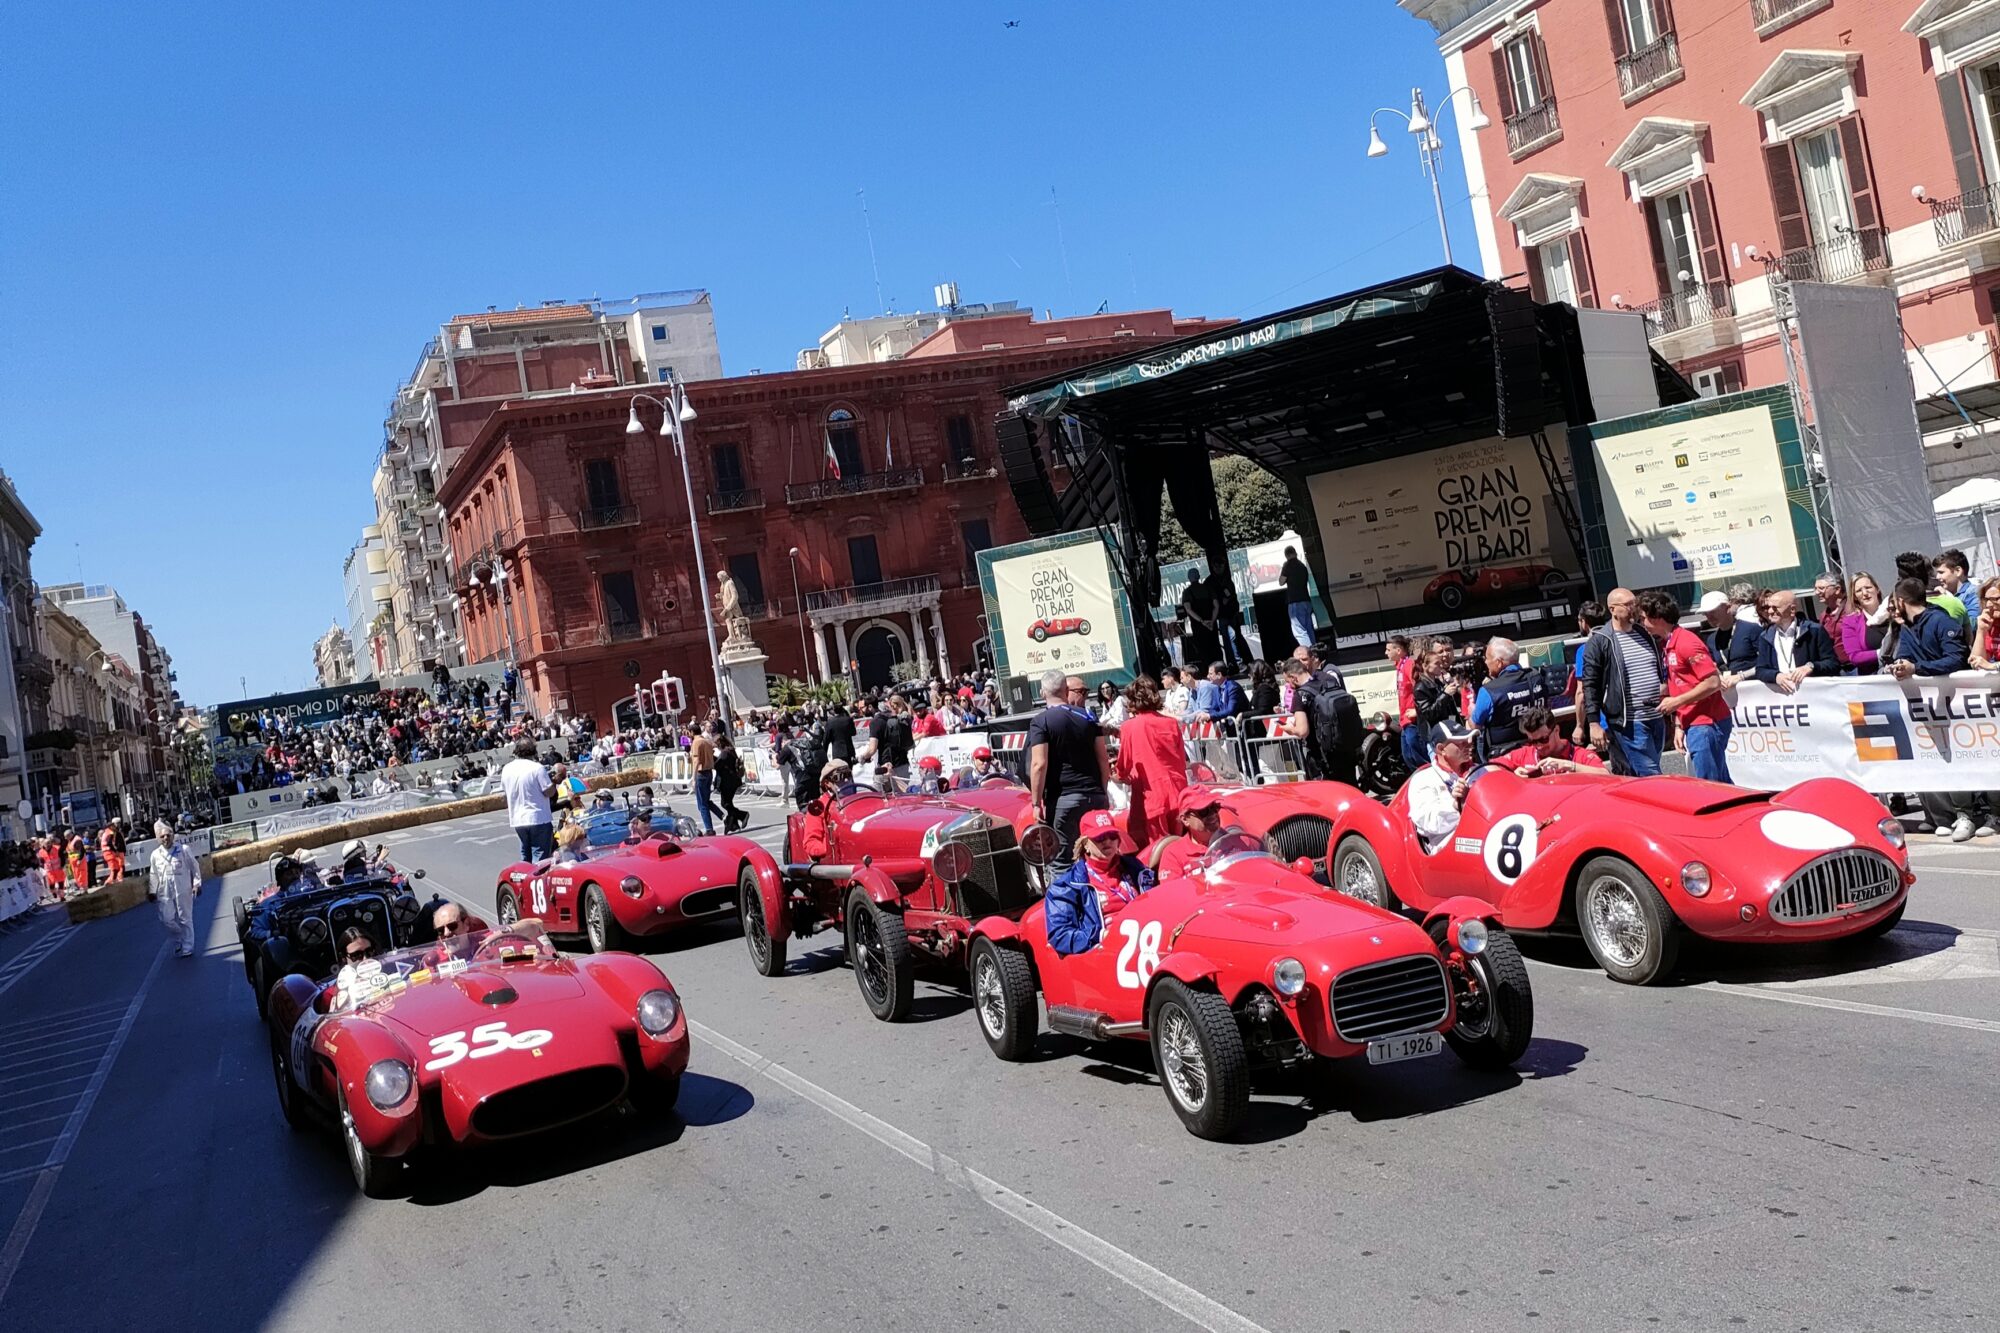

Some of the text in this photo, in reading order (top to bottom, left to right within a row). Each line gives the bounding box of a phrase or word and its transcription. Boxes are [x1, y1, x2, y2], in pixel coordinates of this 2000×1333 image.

[1181, 340, 1226, 366] PREMIO
[1232, 335, 1245, 351] DI
[1250, 324, 1276, 346] BARI
[1437, 465, 1519, 505] GRAN
[1434, 496, 1531, 539] PREMIO
[1445, 526, 1531, 568] DI BARI
[1032, 567, 1069, 587] GRAN
[1030, 582, 1074, 603] PREMIO
[1036, 598, 1075, 618] DI BARI
[326, 698, 340, 713] DI
[1367, 690, 1397, 700] SIKURH
[1731, 704, 1811, 728] LLEFFE
[1728, 731, 1796, 754] STORE
[280, 818, 315, 830] Autotrend
[1497, 824, 1524, 878] 8
[530, 879, 547, 914] 18
[1117, 919, 1162, 989] 28
[425, 1021, 553, 1071] 350
[1378, 1043, 1391, 1060] TI
[1402, 1036, 1433, 1056] 1926
